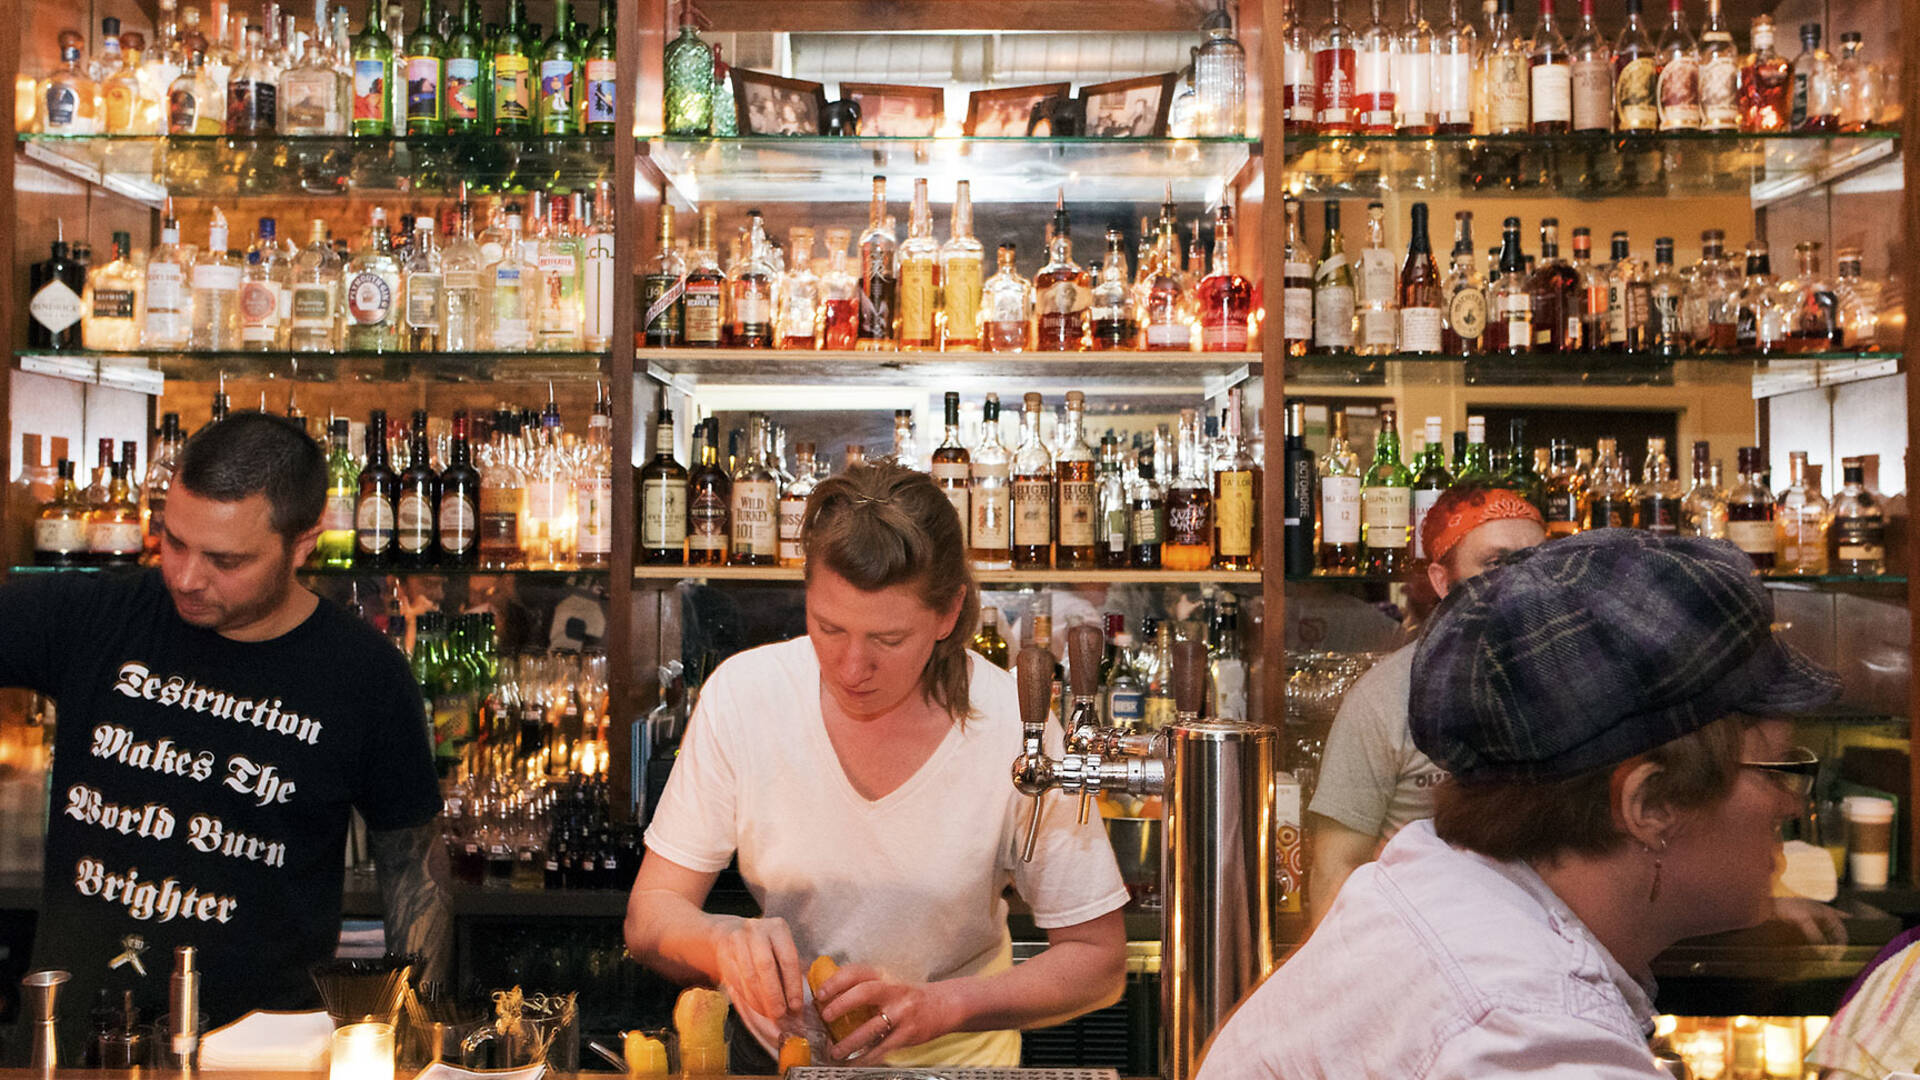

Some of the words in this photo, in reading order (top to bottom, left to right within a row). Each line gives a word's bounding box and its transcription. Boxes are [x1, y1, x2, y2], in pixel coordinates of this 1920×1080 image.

[741, 497, 764, 509] WILD
[1016, 484, 1049, 494] HIGH
[1299, 460, 1310, 518] OCTOMORE
[737, 508, 768, 521] TURKEY
[1341, 511, 1351, 521] 12
[90, 724, 216, 783] Makes
[222, 756, 297, 808] The
[63, 785, 177, 841] World
[186, 815, 287, 869] Burn
[74, 858, 239, 925] Brighter
